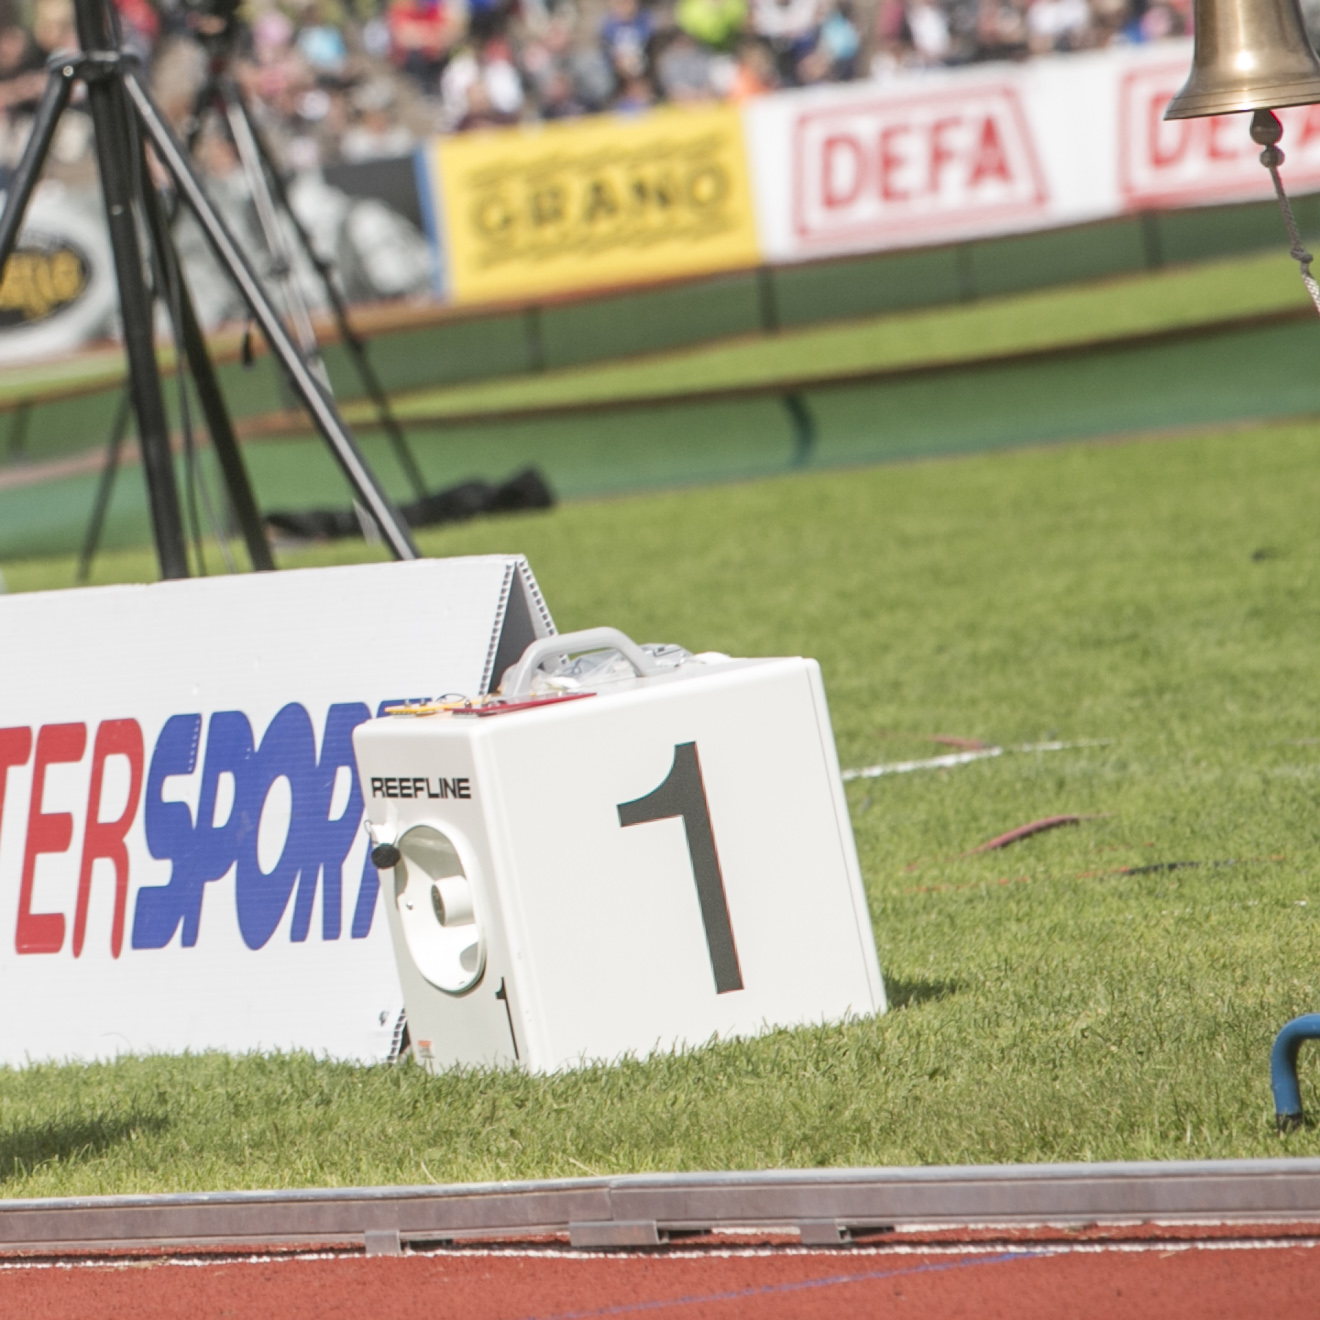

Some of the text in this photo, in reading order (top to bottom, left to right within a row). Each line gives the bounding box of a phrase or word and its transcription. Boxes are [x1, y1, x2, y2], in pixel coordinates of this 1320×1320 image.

[820, 112, 1015, 212] DEFA
[371, 777, 472, 800] REEFLINE
[616, 740, 744, 995] 1
